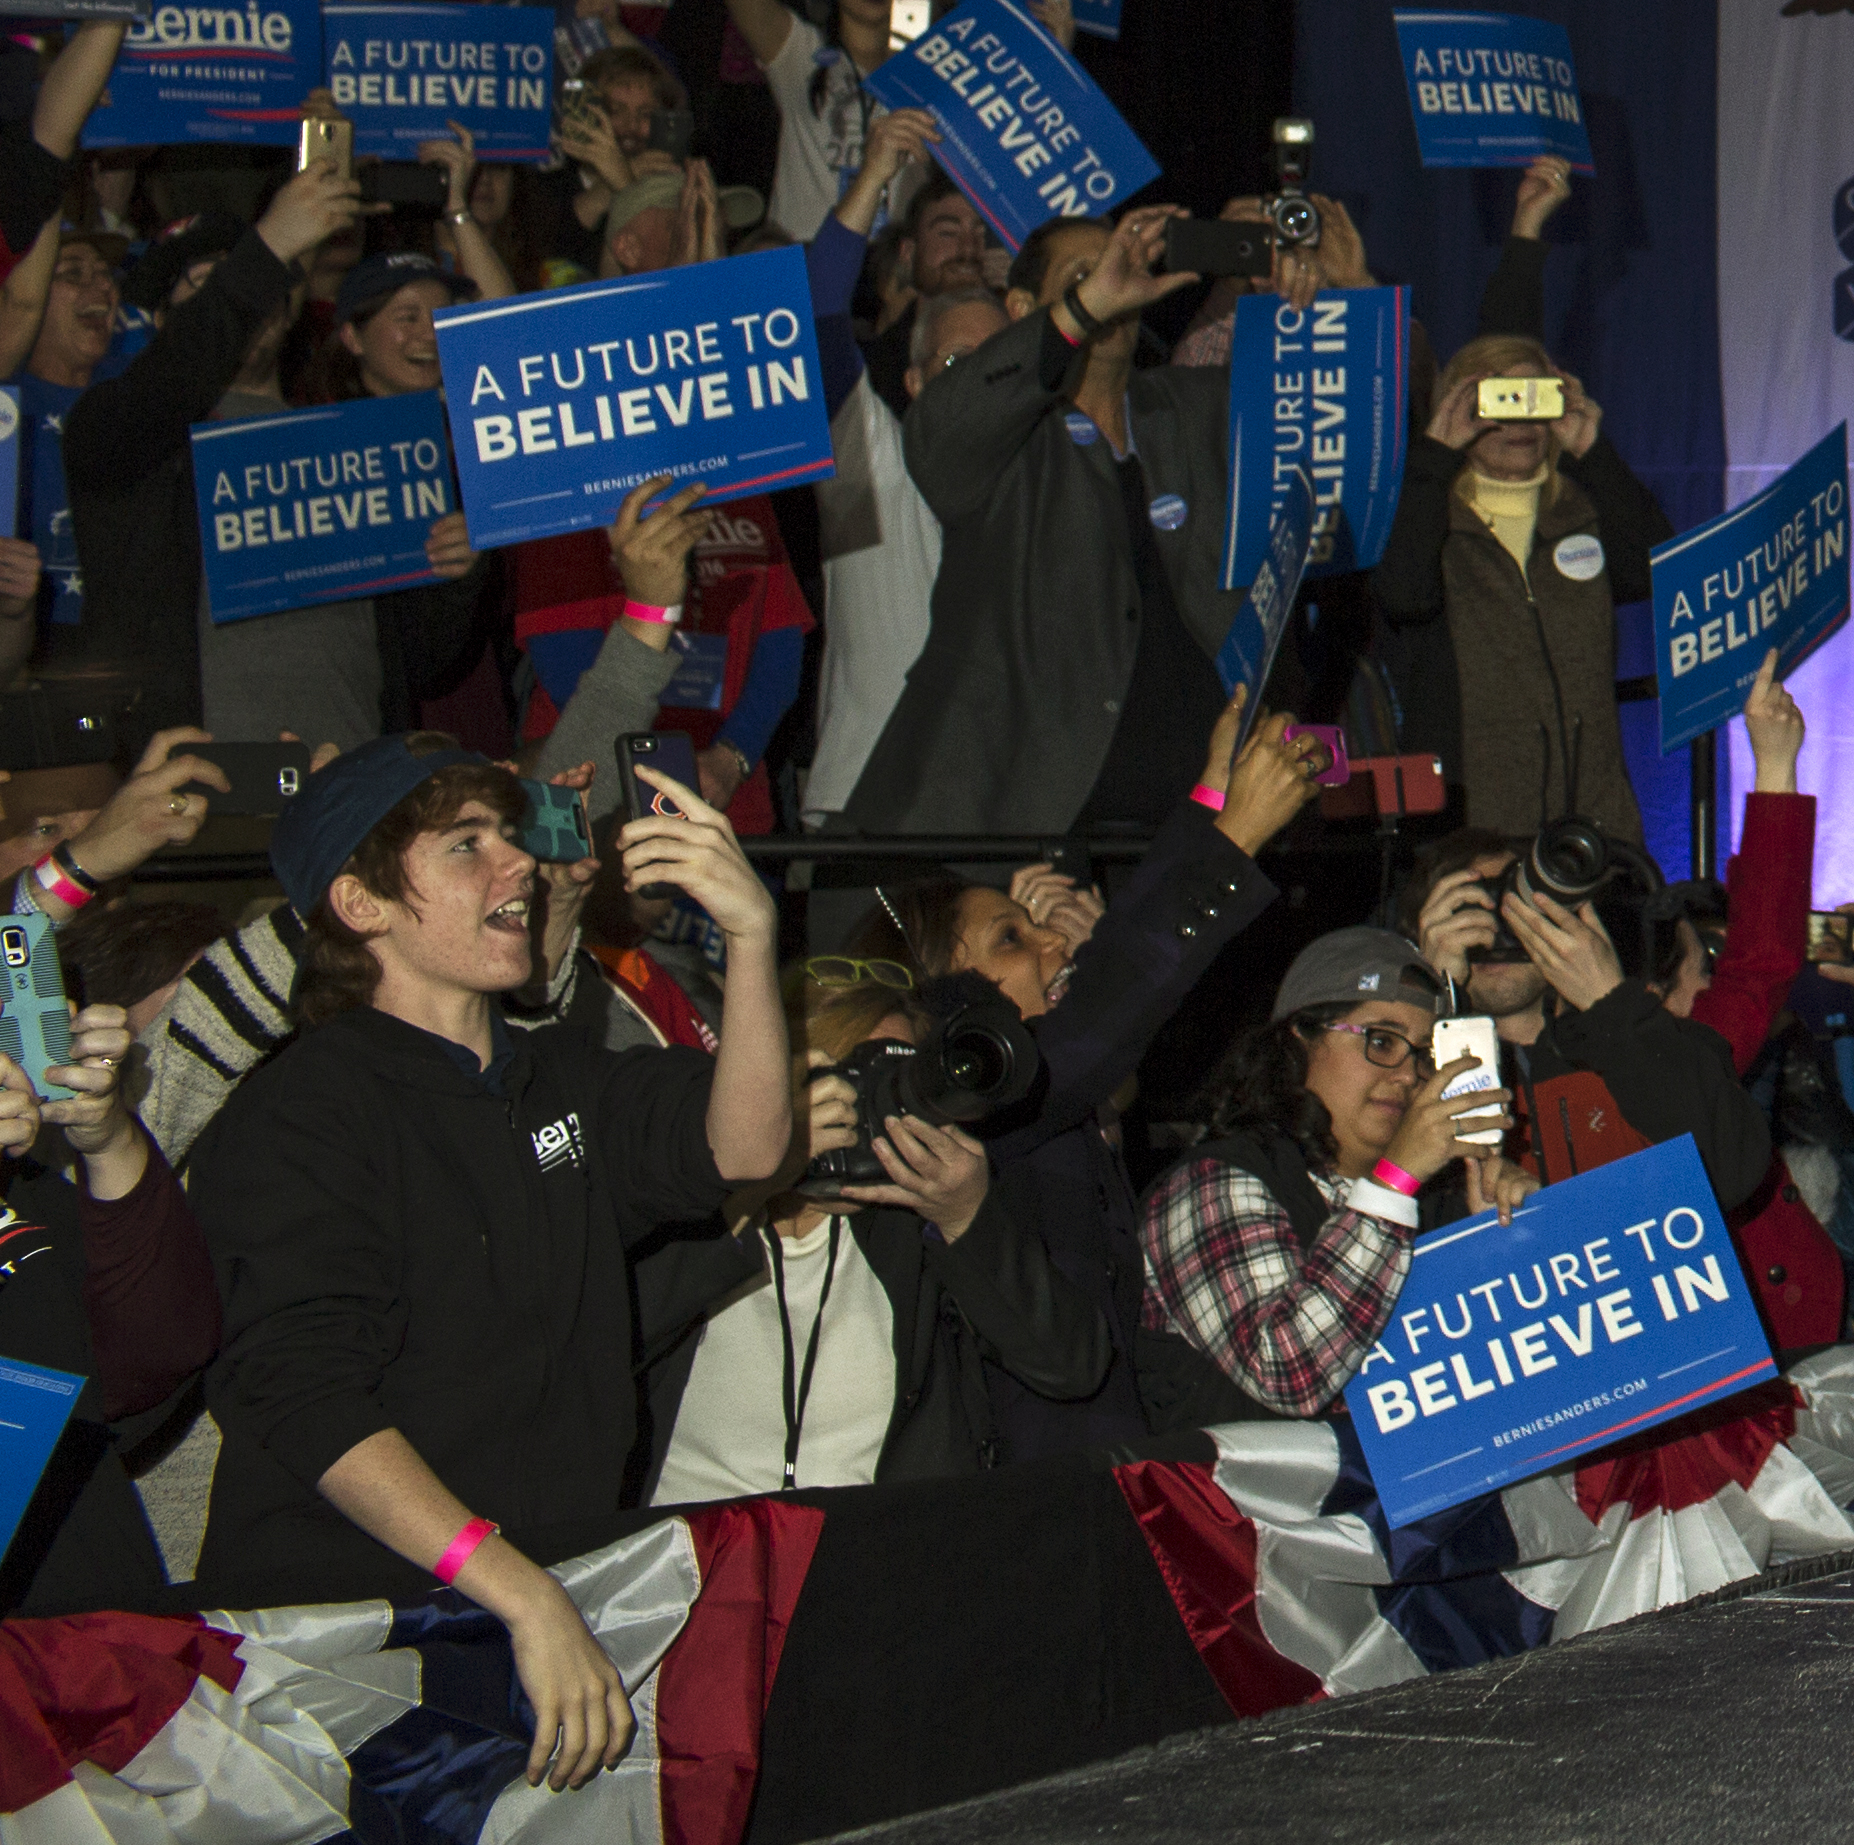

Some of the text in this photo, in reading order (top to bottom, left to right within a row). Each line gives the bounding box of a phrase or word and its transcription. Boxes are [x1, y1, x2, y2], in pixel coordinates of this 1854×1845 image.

[330, 73, 546, 111] BELIEVE IN
[331, 41, 546, 74] A FUTURE TO
[1414, 47, 1573, 88] A FUTURE TO
[914, 33, 1091, 218] BELIEVE IN
[945, 16, 1116, 200] A FUTURE TO
[1417, 81, 1581, 125] BELIEVE IN
[470, 307, 799, 406] A FUTURE TO
[1274, 303, 1305, 364] TO
[1311, 299, 1349, 353] IN
[472, 355, 812, 463] BELIEVE IN
[212, 438, 439, 506] A FUTURE TO
[214, 478, 448, 552] BELIEVE IN
[1669, 479, 1843, 630] A FUTURE TO
[1670, 521, 1846, 680] BELIEVE IN
[1361, 1207, 1705, 1376] A FUTURE TO
[1367, 1254, 1730, 1435] BELIEVE IN
[1493, 1378, 1648, 1449] BERNIESANDERS.COM
